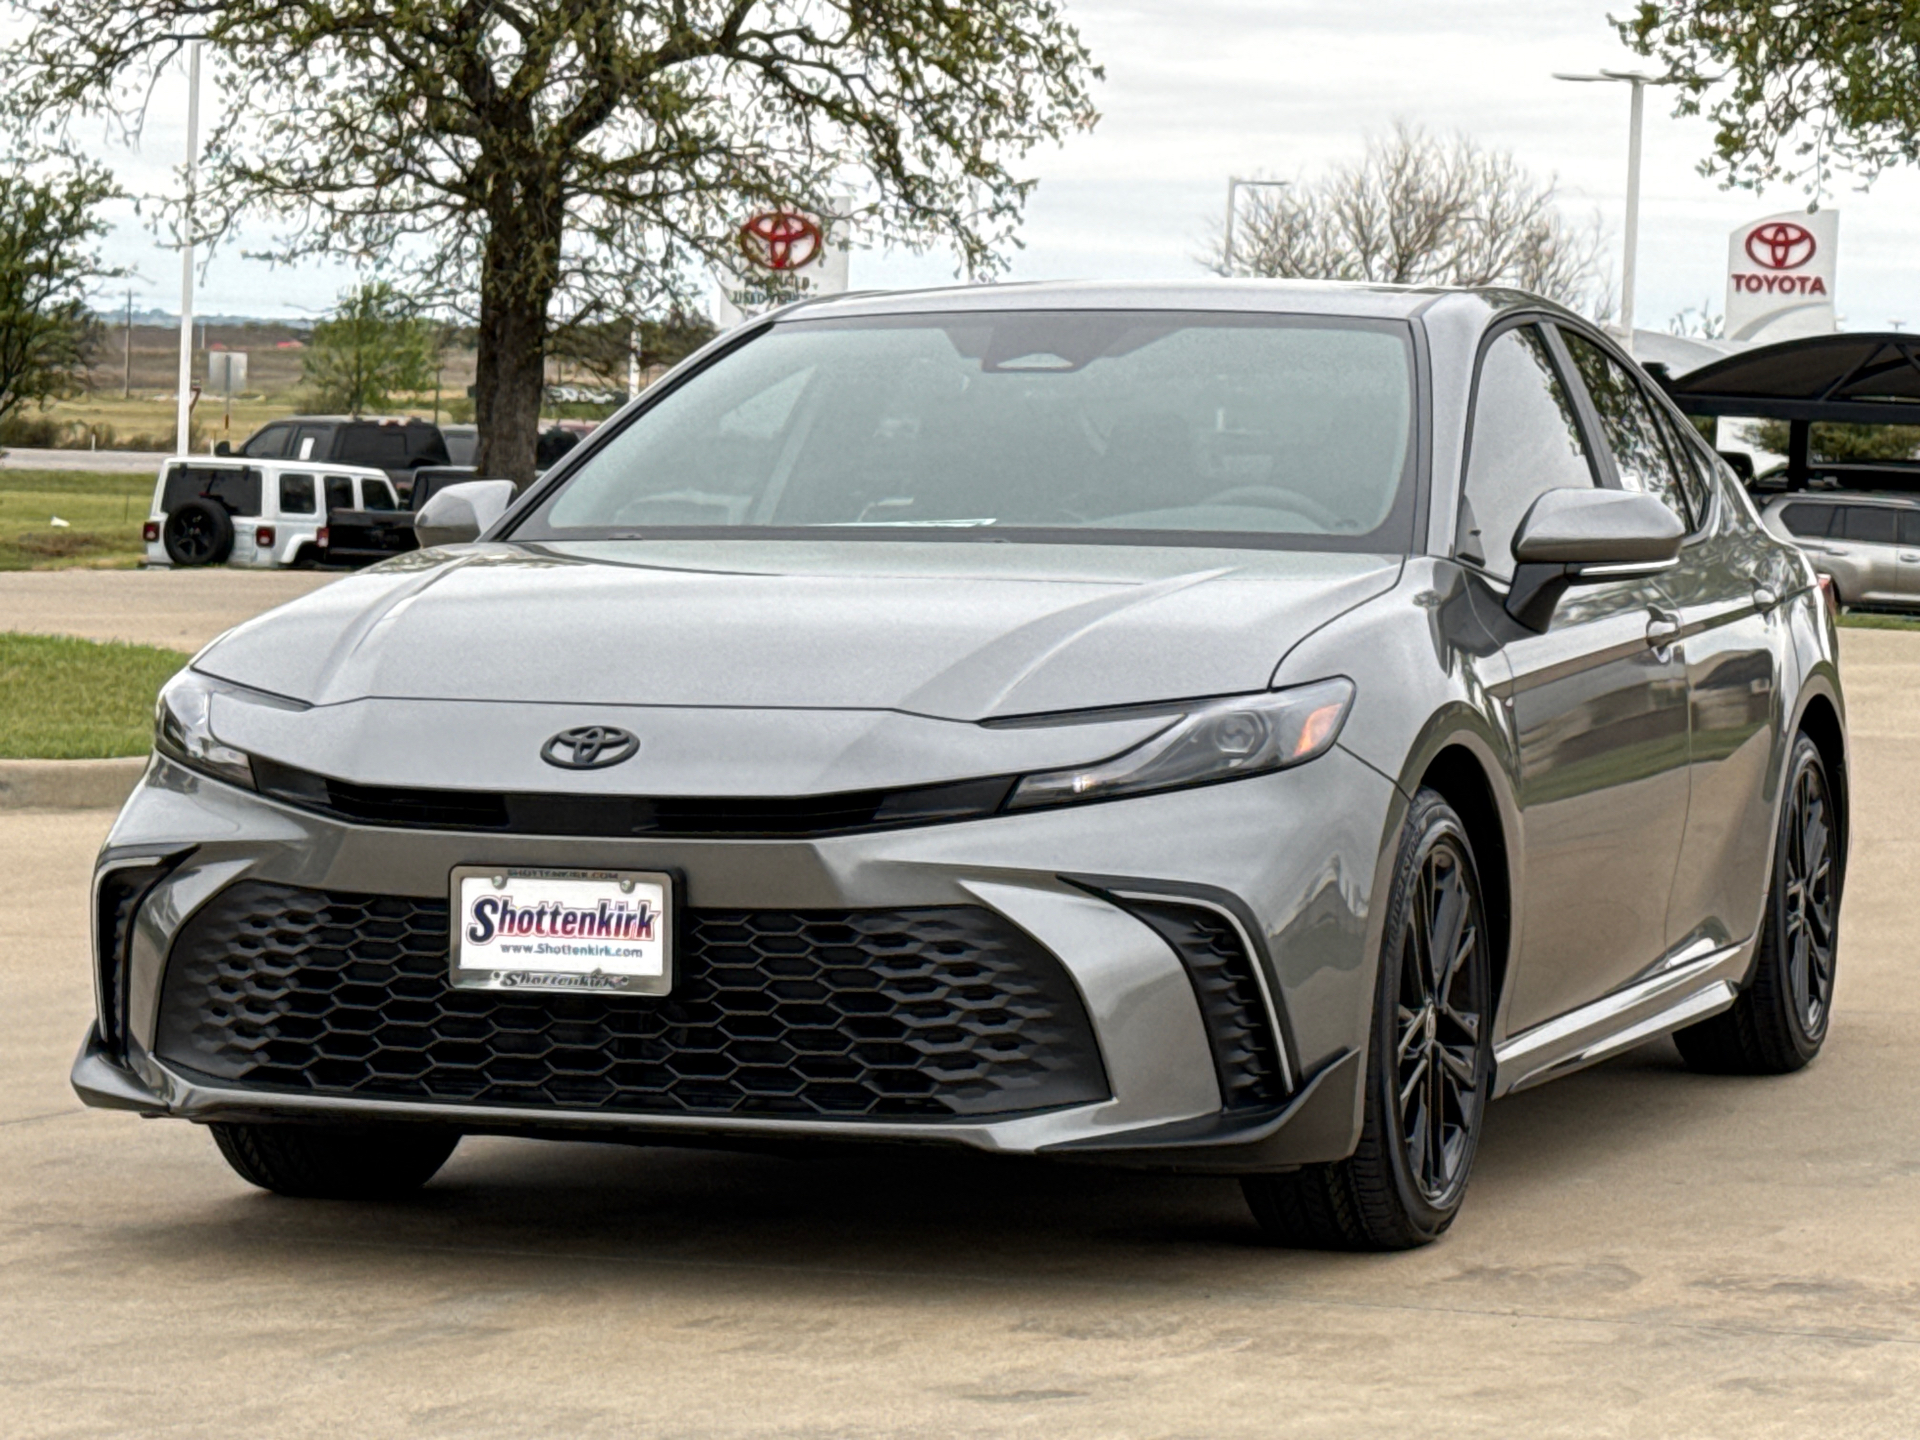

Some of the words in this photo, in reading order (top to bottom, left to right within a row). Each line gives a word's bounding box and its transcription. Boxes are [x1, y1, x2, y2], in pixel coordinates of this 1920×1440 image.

[1731, 274, 1826, 296] TOYOTA
[467, 897, 657, 943] Shottenkirk
[500, 943, 642, 958] www.Shottenkirk.com
